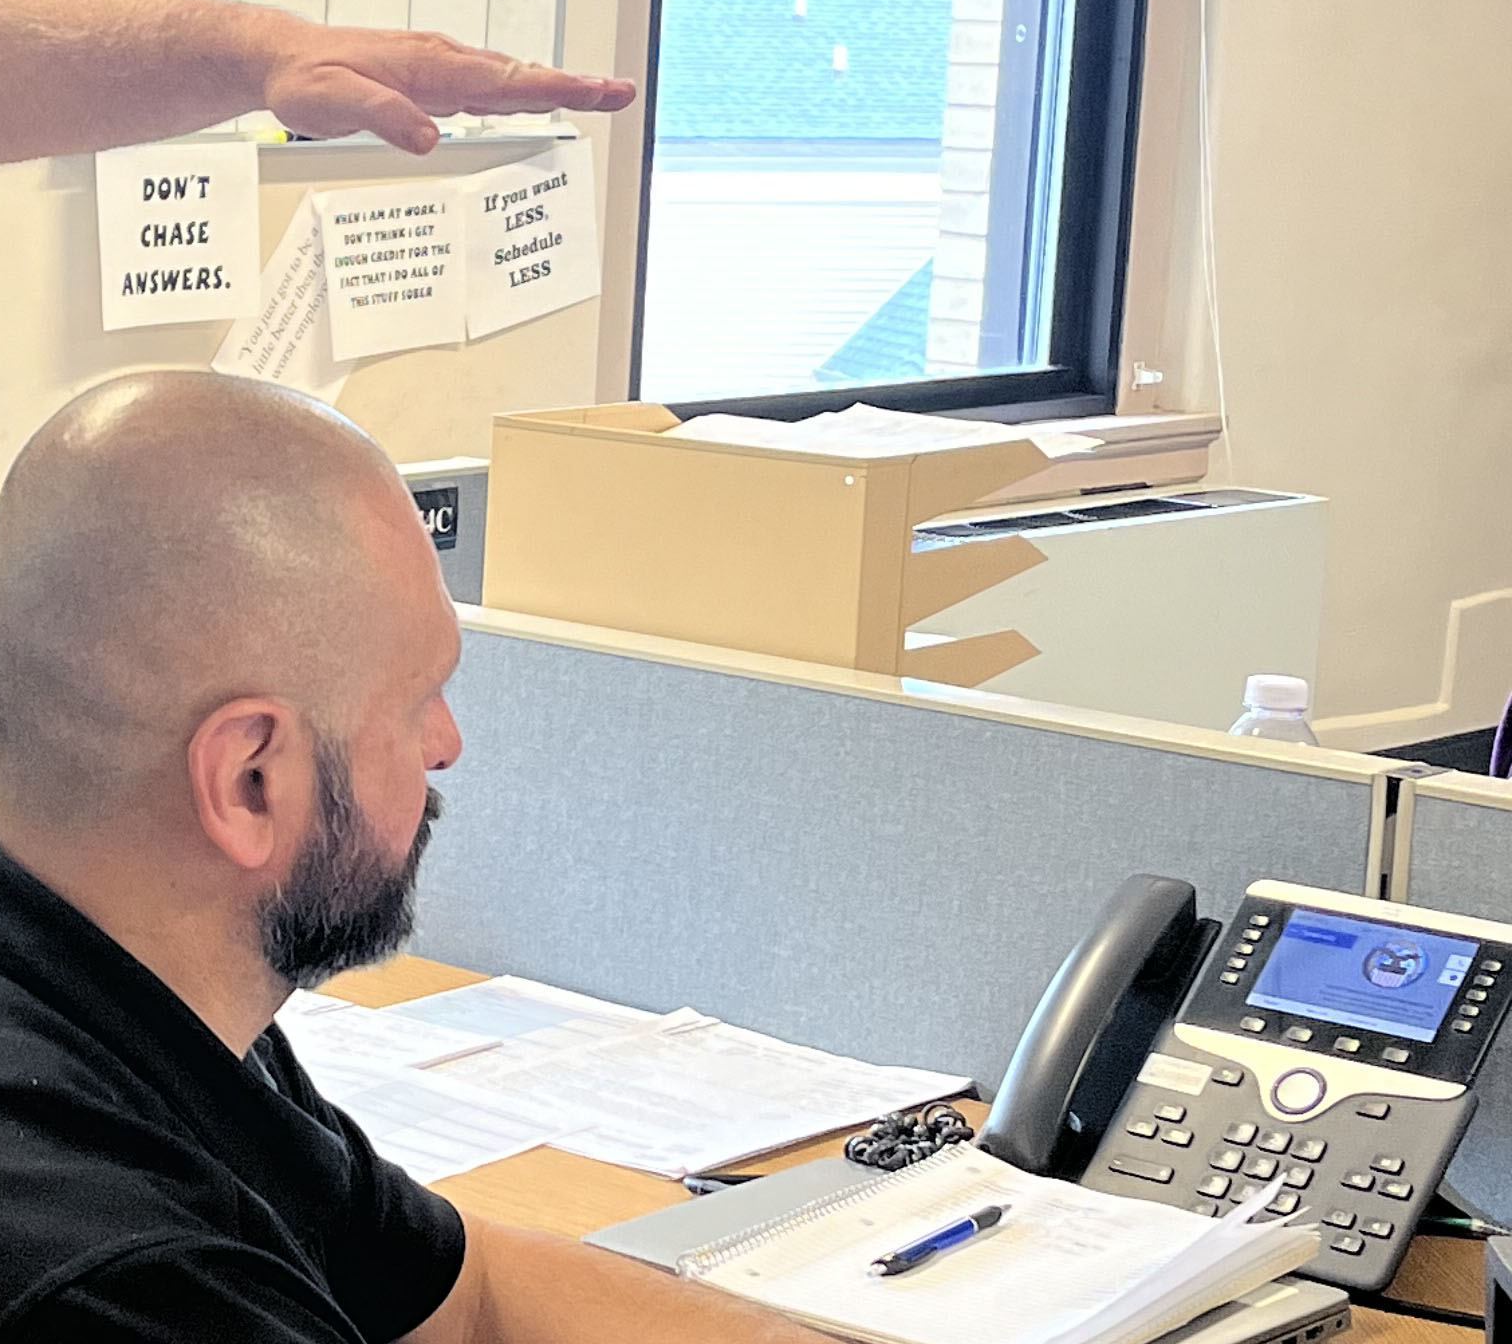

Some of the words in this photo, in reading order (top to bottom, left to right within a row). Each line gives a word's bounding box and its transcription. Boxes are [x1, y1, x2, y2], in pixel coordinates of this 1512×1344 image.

[142, 174, 210, 201] DON'T
[484, 193, 499, 213] If
[501, 188, 528, 211] you
[532, 172, 568, 196] want
[369, 210, 385, 221] AM
[388, 208, 401, 219] AT
[141, 221, 209, 247] CHASE
[375, 228, 405, 242] THINK
[371, 249, 405, 262] CREDIT
[408, 246, 428, 258] FOR
[431, 243, 451, 255] THE
[494, 232, 563, 266] Schedule
[122, 265, 231, 296] ANSWERS.
[261, 297, 279, 329] just
[276, 272, 293, 301] got
[290, 257, 302, 272] to
[298, 239, 313, 256] be
[362, 272, 386, 285] THAT
[395, 269, 408, 281] DO
[410, 266, 428, 278] ALL
[509, 260, 551, 288] LESS
[372, 291, 399, 305] STUFF
[401, 286, 433, 300] SOBER
[252, 342, 275, 375] little
[271, 300, 299, 341] better
[272, 343, 297, 379] worst
